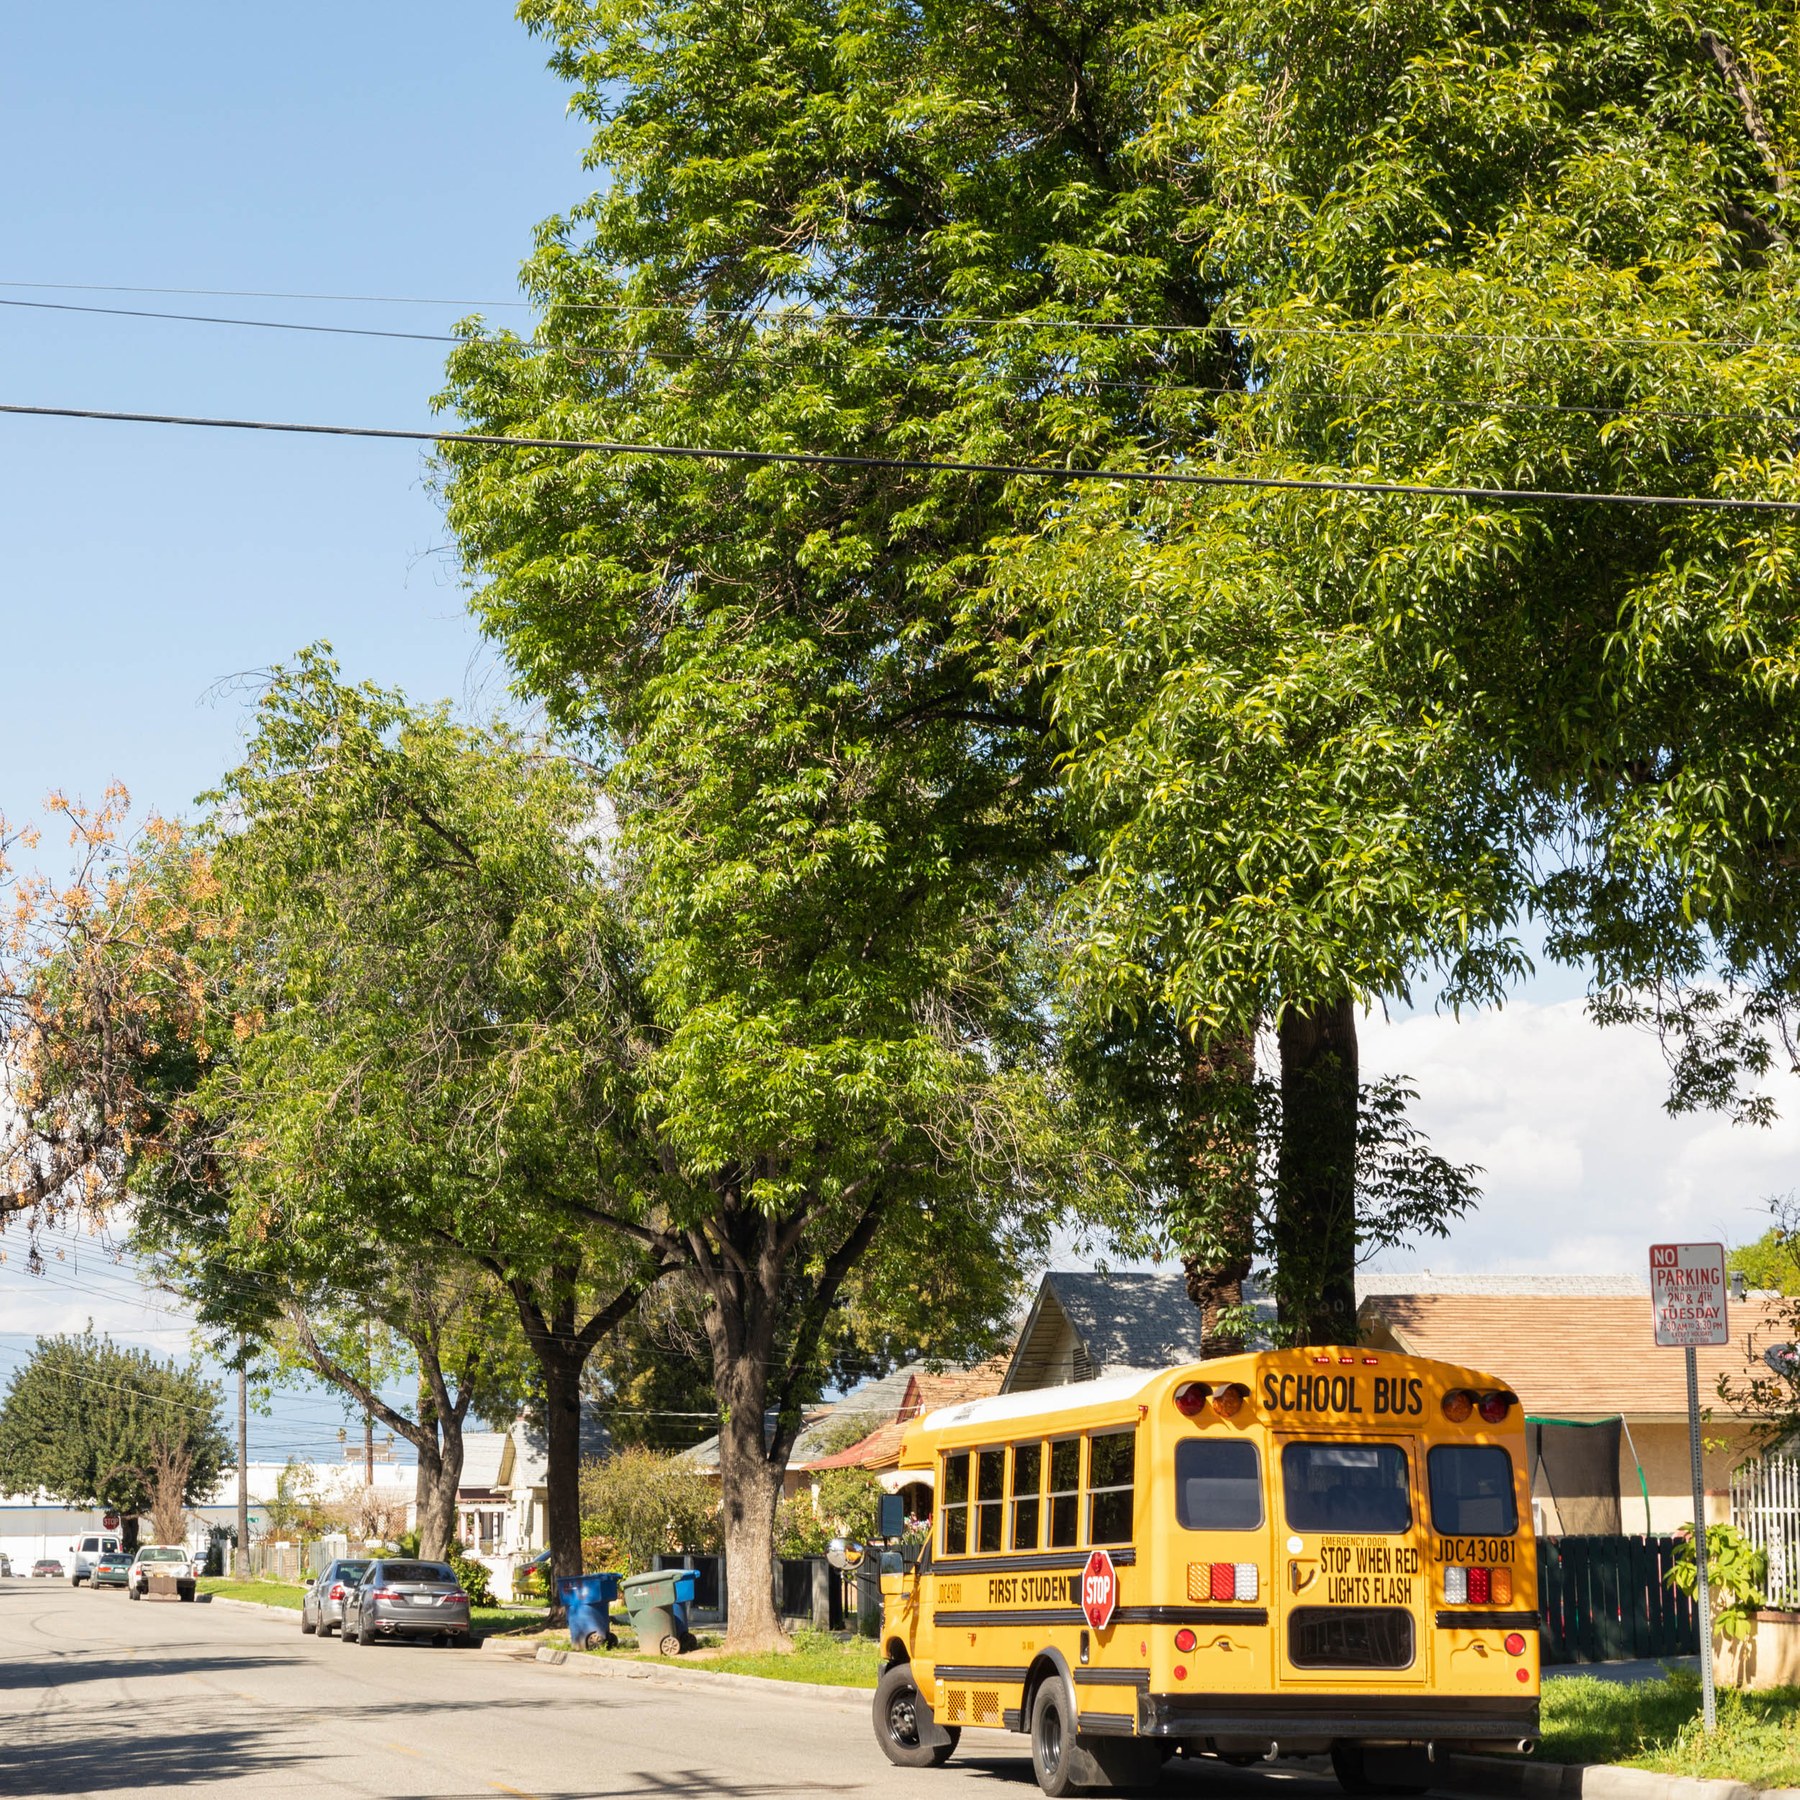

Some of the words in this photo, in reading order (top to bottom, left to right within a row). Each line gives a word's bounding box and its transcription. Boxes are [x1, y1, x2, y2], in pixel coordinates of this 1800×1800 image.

[1654, 1248, 1675, 1265] NO
[1657, 1268, 1720, 1286] PARKING
[1668, 1292, 1684, 1307] 2ND
[1686, 1294, 1693, 1304] &
[1698, 1292, 1713, 1306] 4TH
[1661, 1307, 1720, 1320] TUESDAY
[1659, 1321, 1676, 1331] 7:30
[1695, 1320, 1711, 1330] 3:30
[1263, 1373, 1362, 1413] SCHOOL
[1374, 1377, 1423, 1415] BUS
[1321, 1536, 1365, 1546] EMERGENCY
[1367, 1537, 1387, 1547] DOOR
[1434, 1539, 1515, 1562] JDC43081
[1320, 1546, 1351, 1573] STOP
[1356, 1547, 1391, 1574] WHEN
[1395, 1547, 1418, 1574] RED
[989, 1578, 1018, 1604] FIRST
[1086, 1575, 1110, 1604] STOP
[1328, 1576, 1370, 1604] LIGHTS
[1374, 1577, 1412, 1604] FLASH
